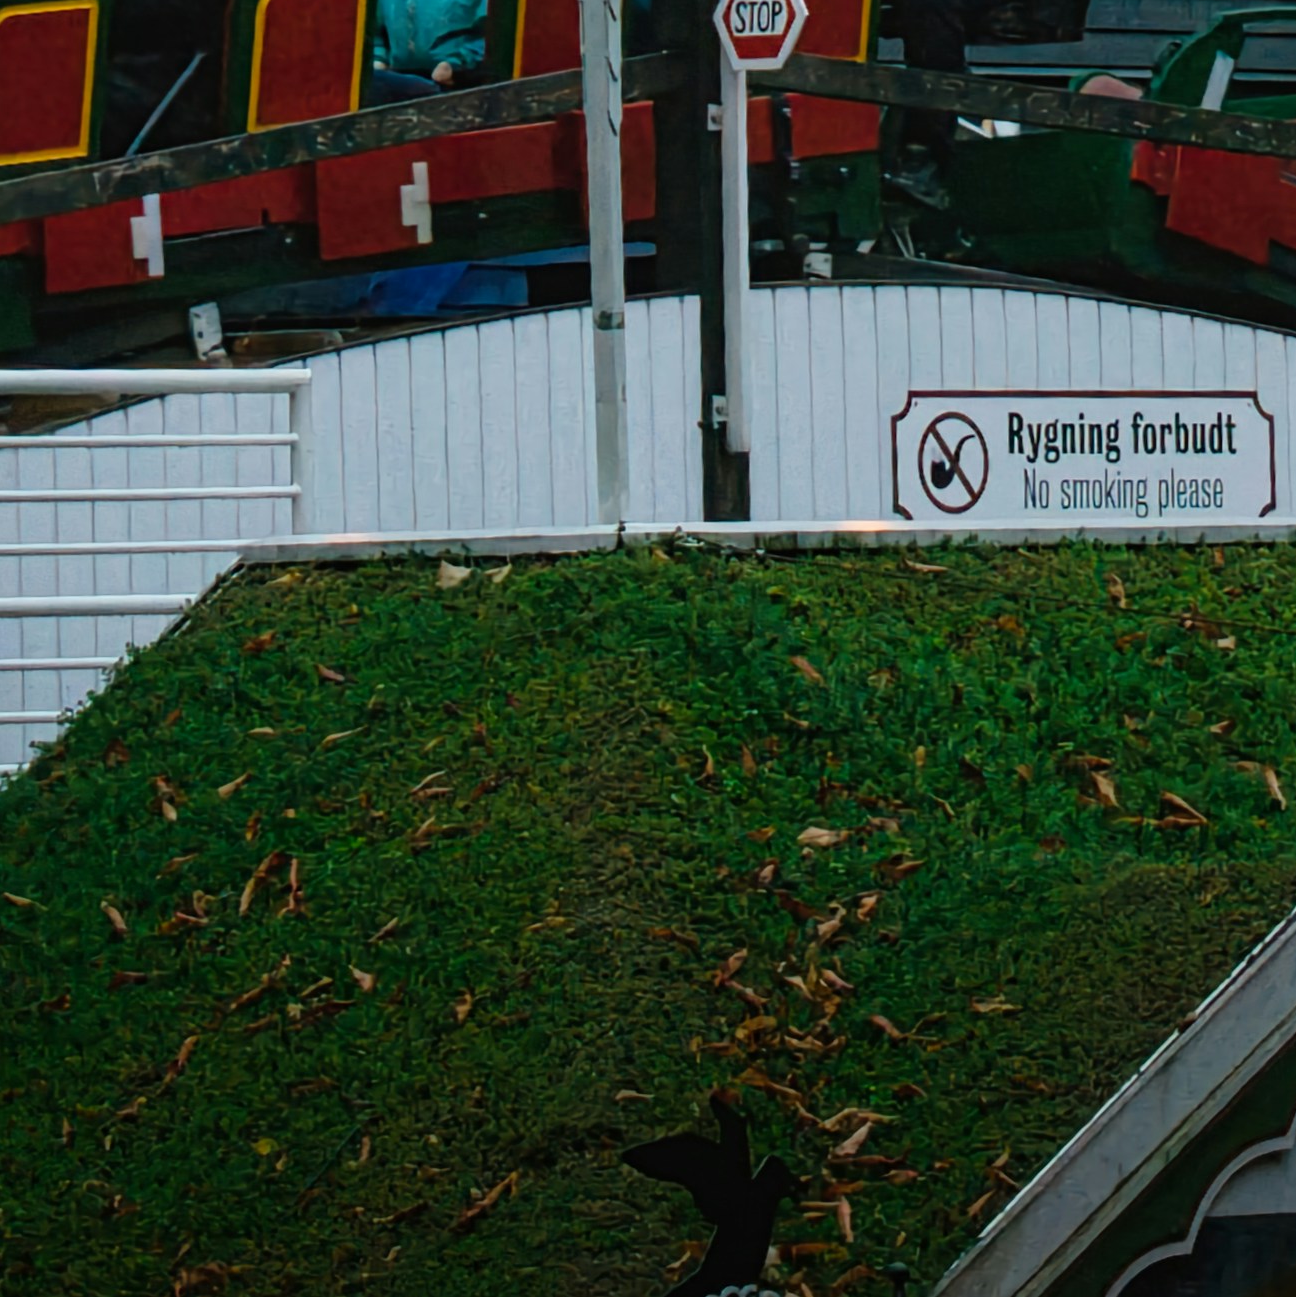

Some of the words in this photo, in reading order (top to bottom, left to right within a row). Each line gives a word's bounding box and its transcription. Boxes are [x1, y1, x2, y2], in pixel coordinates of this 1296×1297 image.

[735, 1, 783, 33] STOP
[1008, 412, 1121, 463] Rygning
[1130, 412, 1236, 454] forbudt
[1023, 468, 1050, 509] No
[1060, 467, 1149, 518] smoking
[1157, 467, 1224, 517] please
